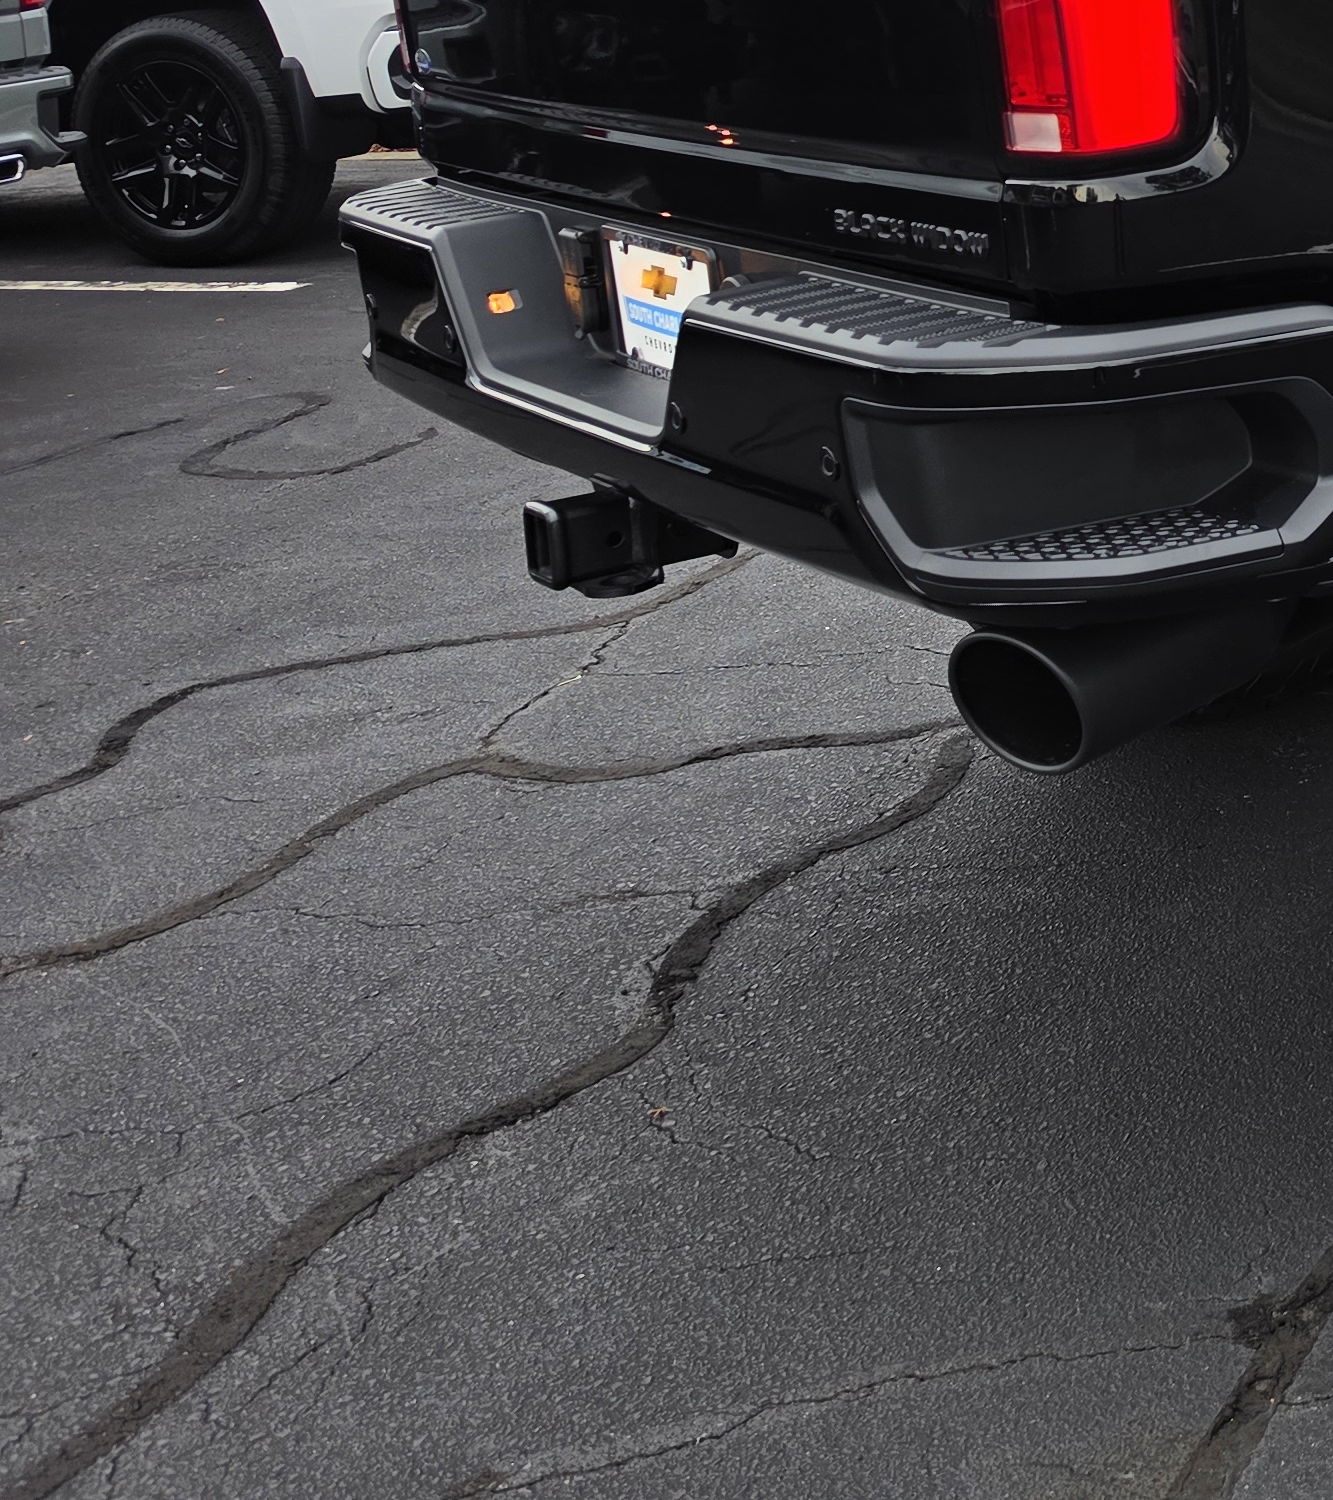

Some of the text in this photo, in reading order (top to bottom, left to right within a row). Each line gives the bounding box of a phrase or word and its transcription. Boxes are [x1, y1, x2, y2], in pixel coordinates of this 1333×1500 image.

[833, 208, 989, 257] BLACK WIDOW
[628, 302, 653, 326] SOUTH
[626, 358, 654, 376] SOUTH
